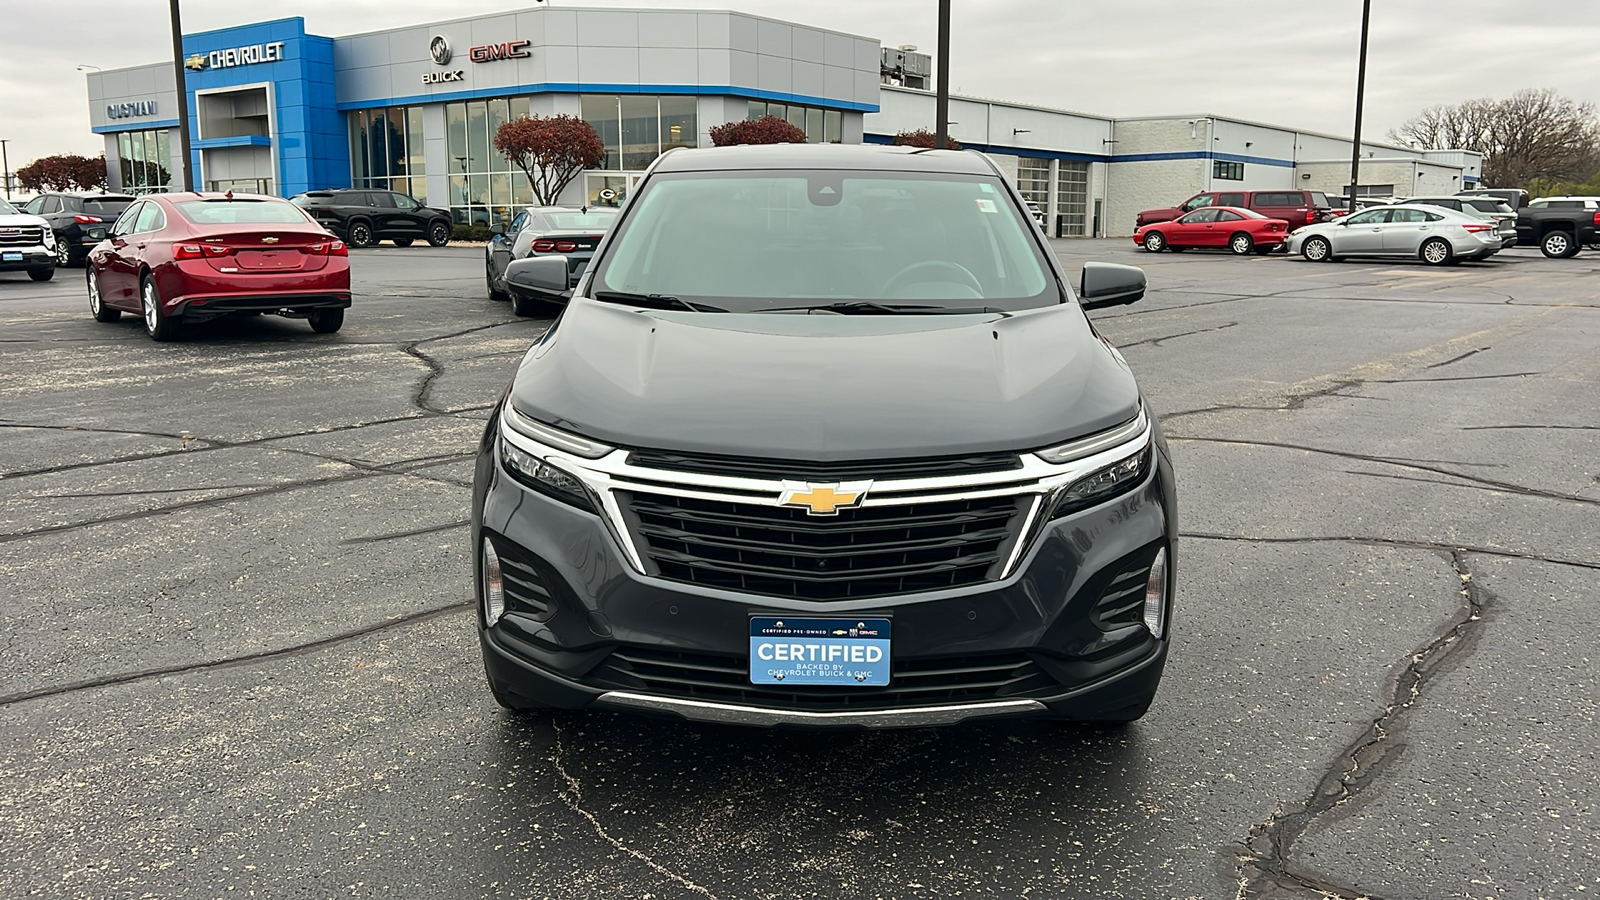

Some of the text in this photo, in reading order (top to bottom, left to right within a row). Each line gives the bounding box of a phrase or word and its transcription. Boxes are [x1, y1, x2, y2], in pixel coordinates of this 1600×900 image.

[209, 41, 284, 69] CHEVROLET
[469, 40, 531, 62] GMC
[421, 70, 463, 84] BUICK
[757, 643, 883, 663] CERTIFIED
[767, 669, 816, 677] CHEVROLET
[796, 663, 829, 671] BACKED
